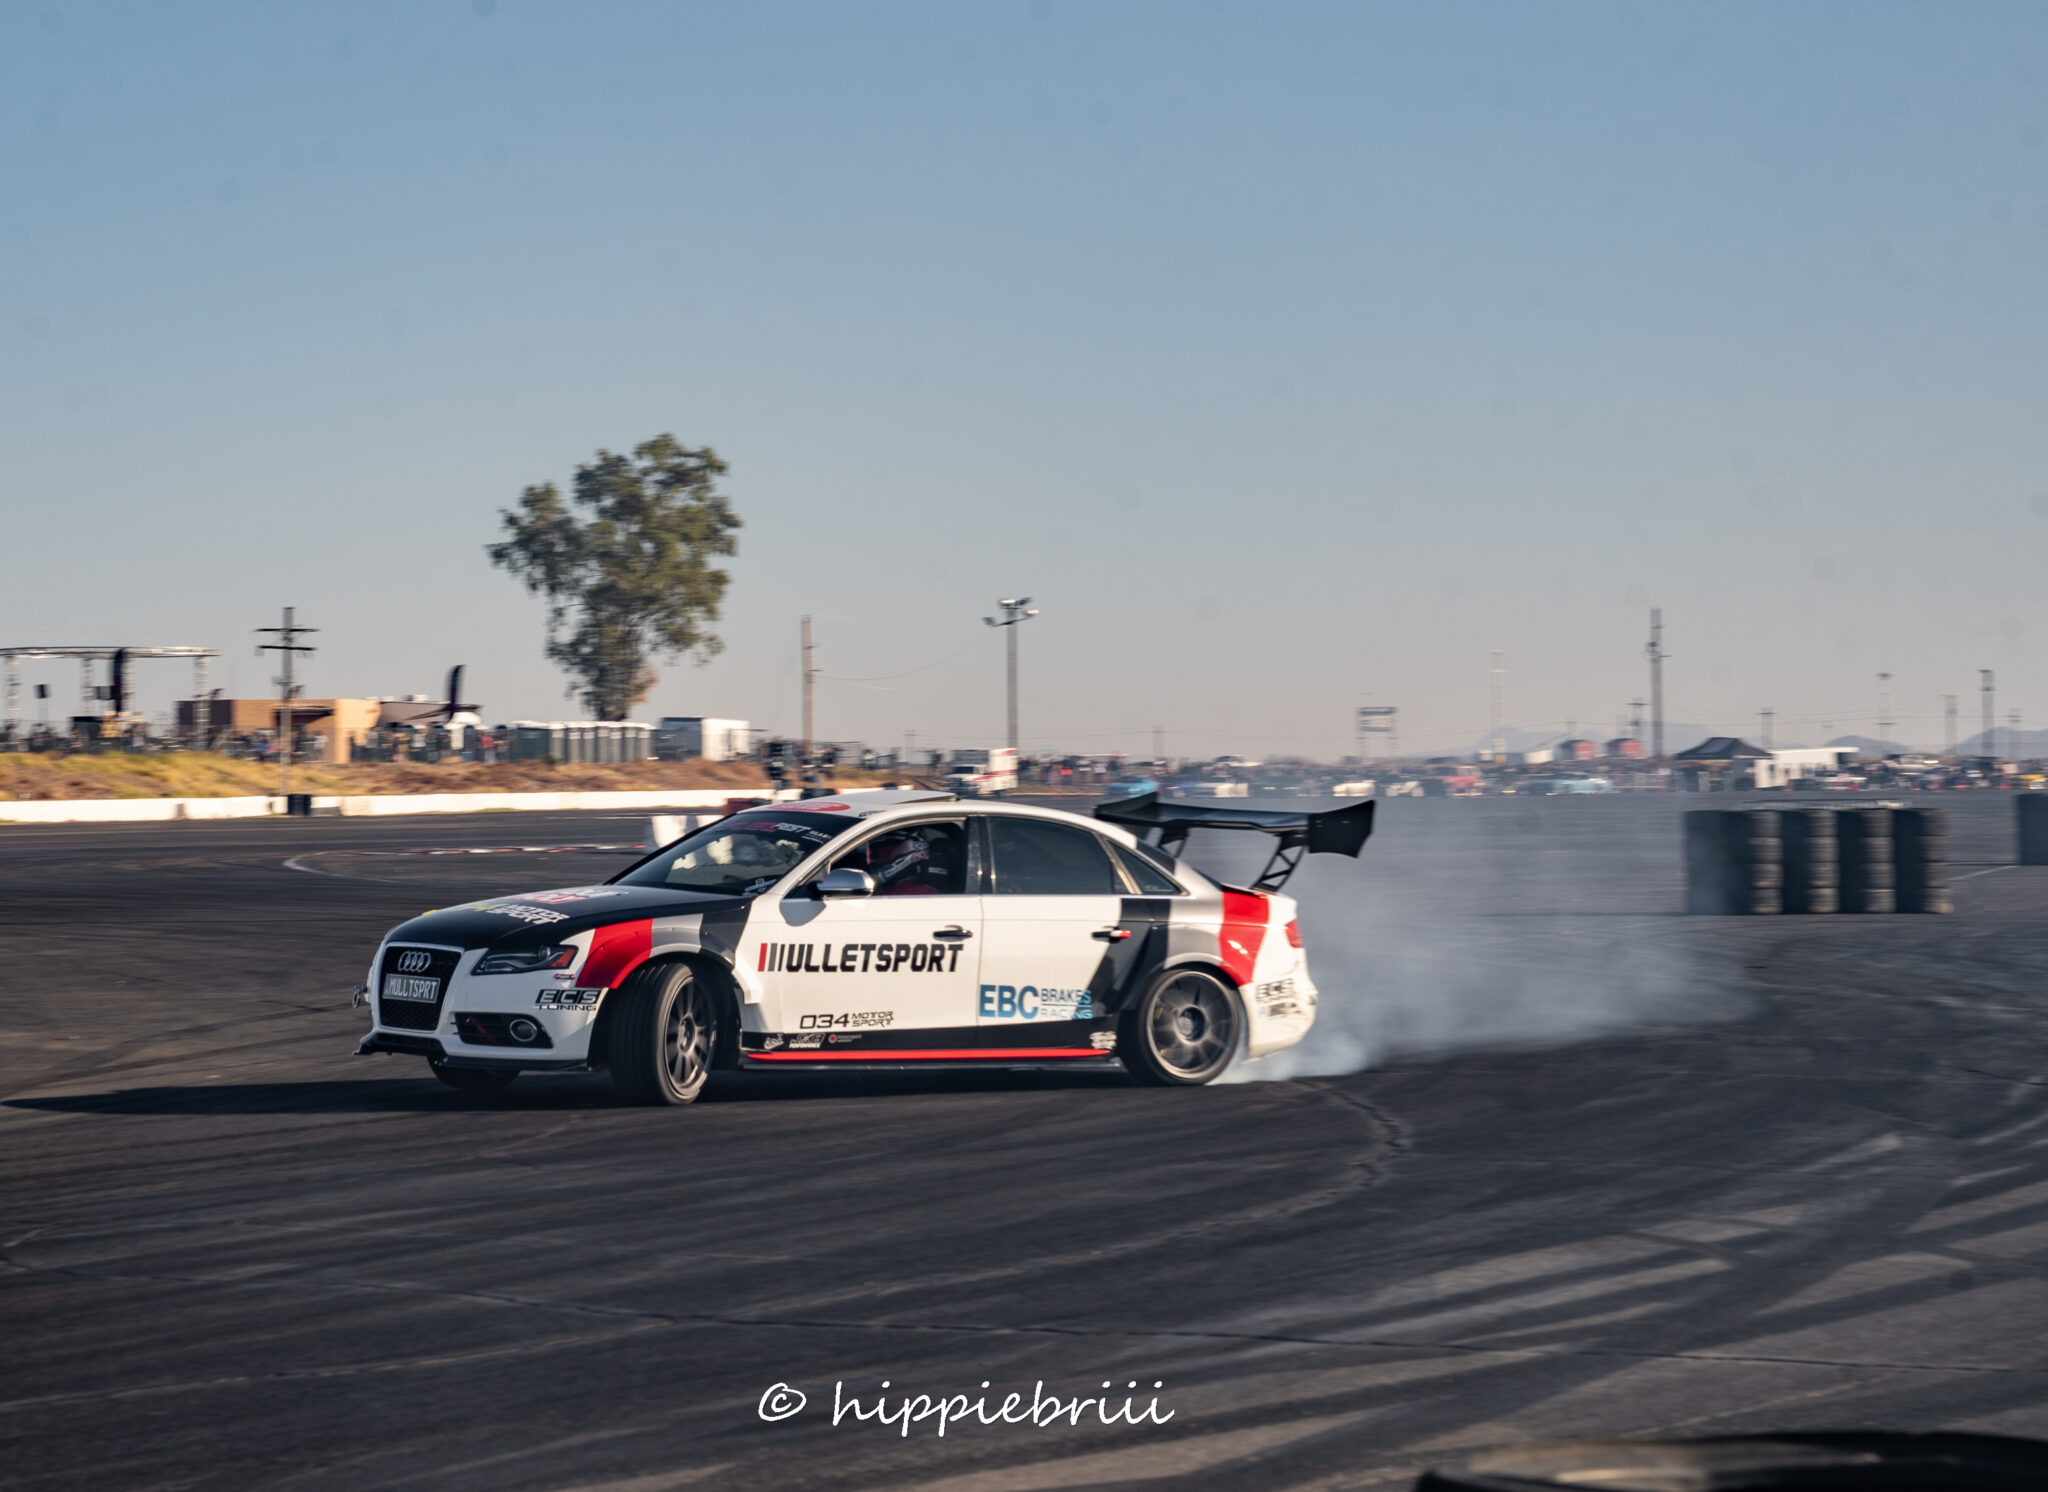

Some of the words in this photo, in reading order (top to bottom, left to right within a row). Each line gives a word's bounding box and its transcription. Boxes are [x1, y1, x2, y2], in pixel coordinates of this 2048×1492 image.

[388, 979, 437, 999] MULLTSPRT
[538, 989, 601, 1003] ECS
[1041, 988, 1092, 1004] BRAKES
[979, 984, 1039, 1019] EBC
[800, 1013, 850, 1029] 034
[852, 1011, 894, 1021] MOTOR
[1041, 1008, 1093, 1020] RACNG
[852, 1019, 892, 1028] SPORT
